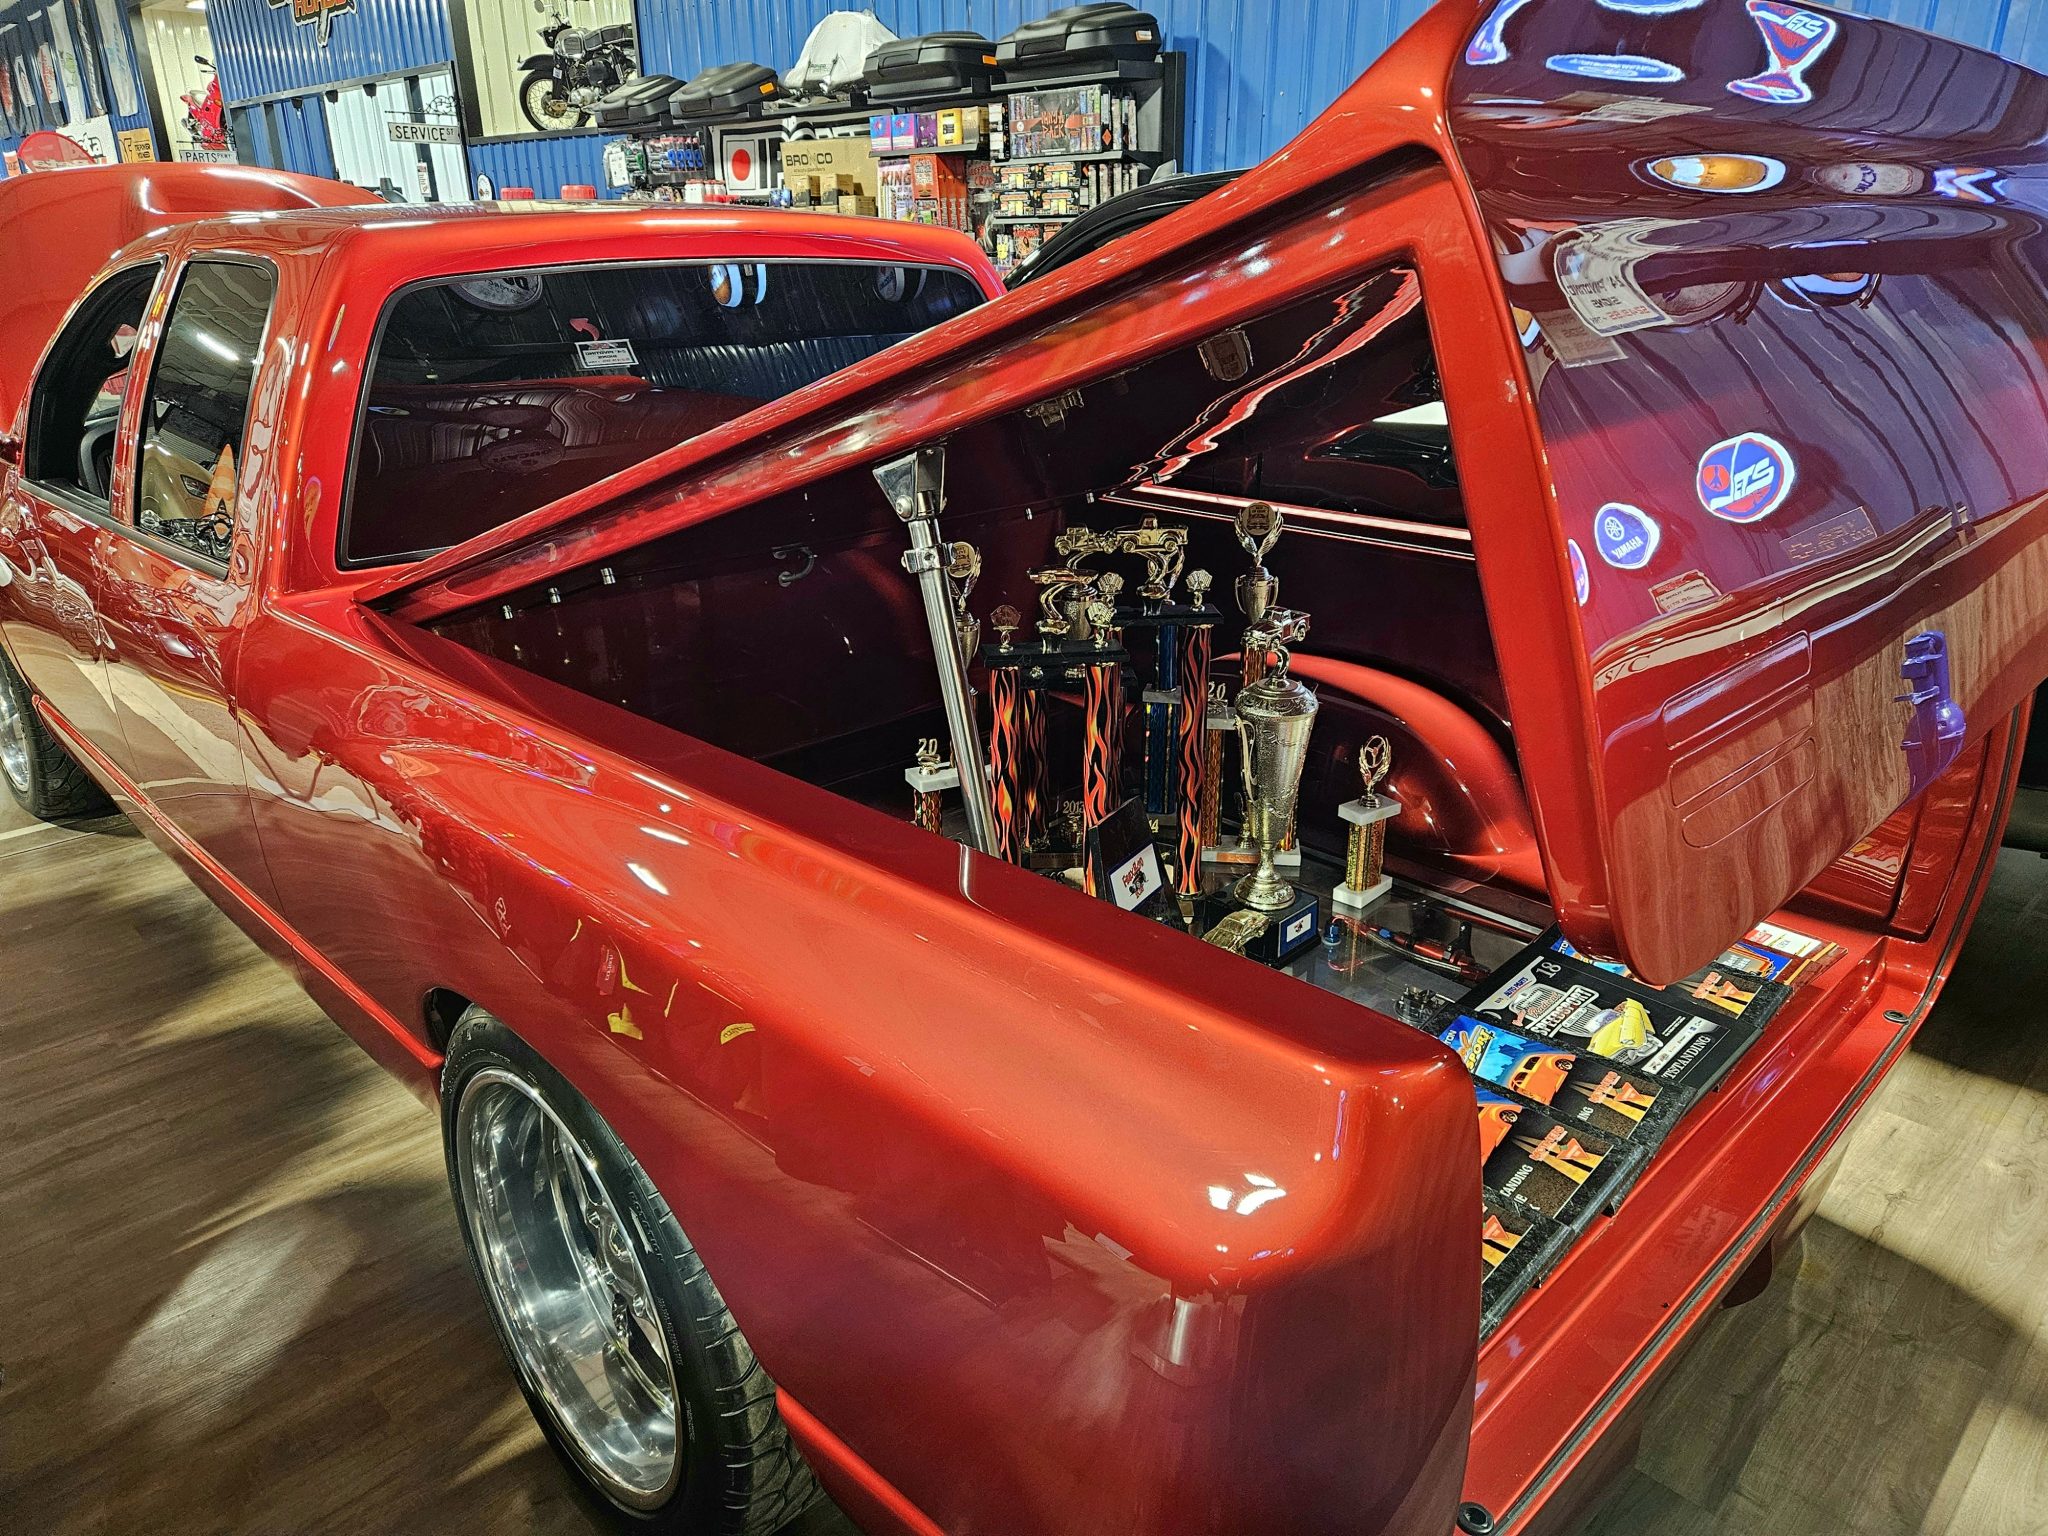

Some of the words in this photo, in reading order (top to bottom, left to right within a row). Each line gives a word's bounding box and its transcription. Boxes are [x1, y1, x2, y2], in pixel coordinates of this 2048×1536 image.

[395, 126, 447, 141] SERVICE
[185, 151, 218, 162] PARTS
[882, 170, 912, 187] KING
[1710, 446, 1774, 510] JETS
[1611, 535, 1644, 559] YAMAHA
[917, 738, 938, 756] 20
[1535, 962, 1562, 978] 18
[1530, 989, 1593, 1037] SPEEDSPORT
[1661, 1036, 1712, 1080] TSTANDING
